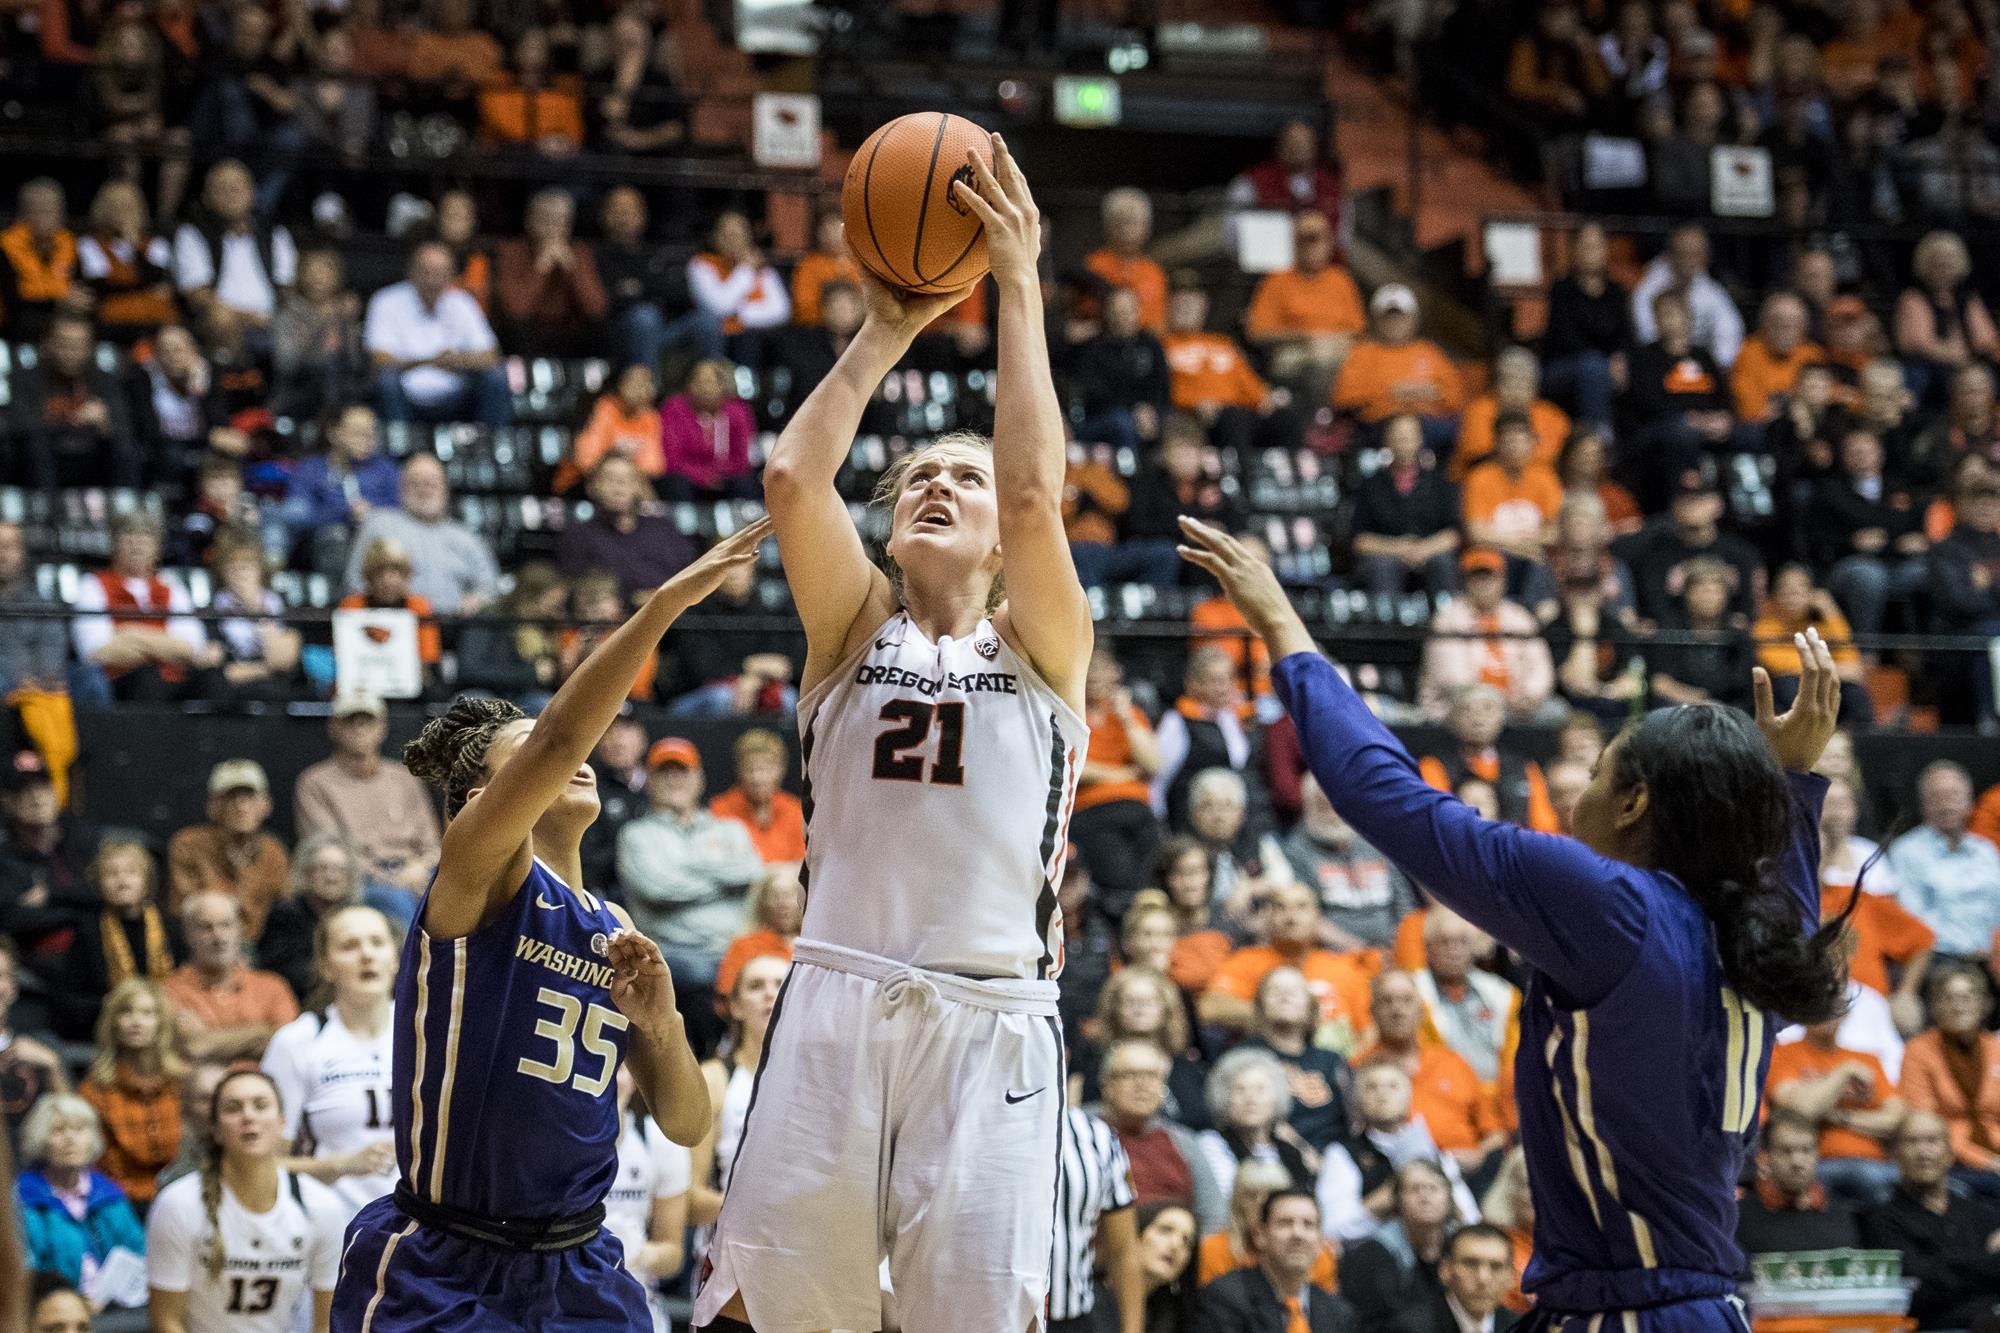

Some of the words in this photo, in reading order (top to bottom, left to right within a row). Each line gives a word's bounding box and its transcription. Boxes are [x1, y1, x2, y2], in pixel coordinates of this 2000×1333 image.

[948, 671, 1017, 695] STATE
[872, 698, 965, 786] 21
[517, 987, 630, 1098] 35
[1720, 987, 1764, 1134] 11
[226, 1276, 281, 1314] 13
